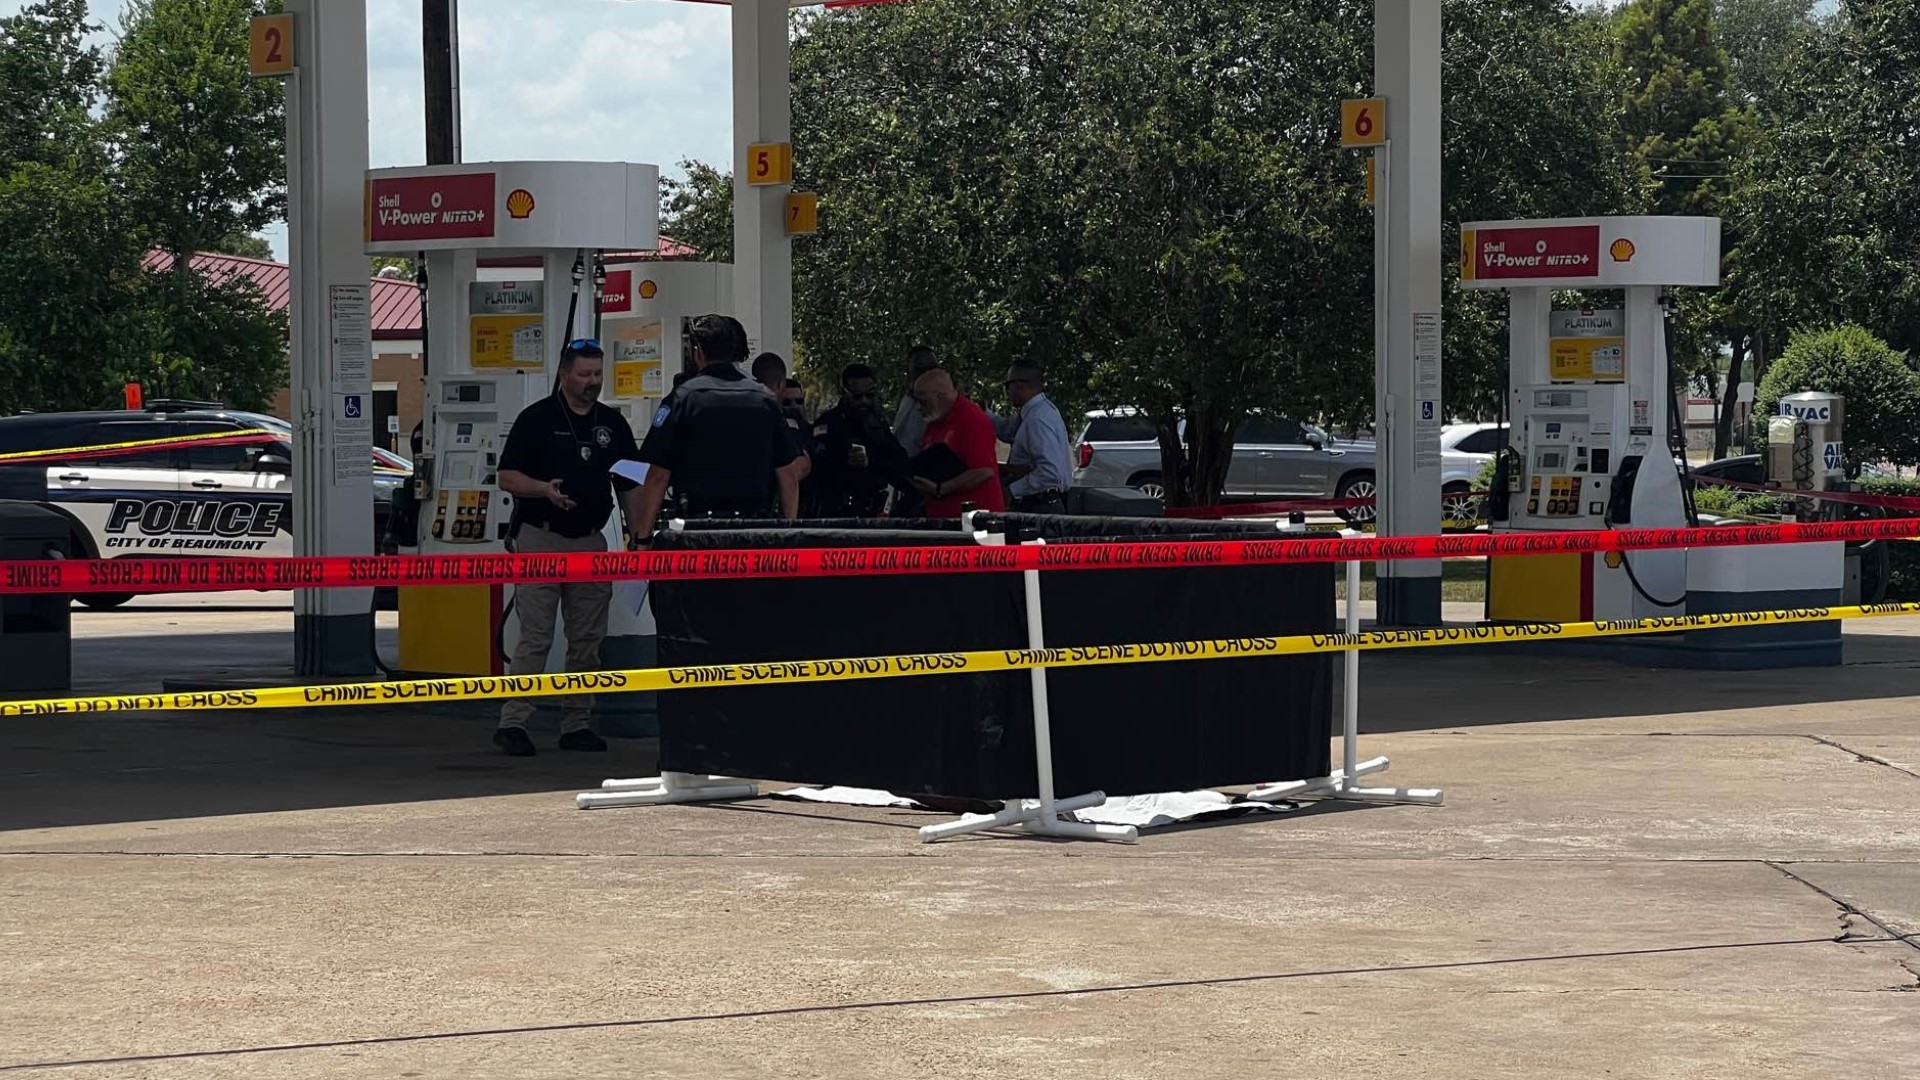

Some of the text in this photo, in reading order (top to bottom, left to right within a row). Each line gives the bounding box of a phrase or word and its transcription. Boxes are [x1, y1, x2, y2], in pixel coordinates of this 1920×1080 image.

[265, 27, 281, 63] 2
[1355, 107, 1373, 136] 6
[757, 151, 769, 177] 5
[378, 193, 400, 208] Shell
[378, 209, 437, 226] V-Power
[792, 206, 799, 221] 7
[1483, 241, 1505, 253] Shell
[1483, 253, 1542, 267] V-Power
[485, 291, 534, 305] PLATINUM
[1564, 317, 1612, 329] PLATINUM
[1794, 407, 1828, 419] VAC
[1825, 443, 1841, 455] AI
[1825, 457, 1841, 469] VA
[104, 498, 285, 538] POLICE
[105, 537, 267, 551] CITY OF BEAUMONT
[350, 556, 568, 581] CRIME SCENE DO NOT CROSS
[592, 553, 799, 576] CRIME SCENE DO NOT CROSS
[820, 549, 1017, 571] CRIME SCENE DO NOT CROSS
[6, 564, 62, 587] CRIME
[89, 561, 324, 586] CRIME SCENE DO NOT CROSS
[1311, 622, 1563, 648] CRIME SCENE DO NOT CROSS
[1005, 637, 1278, 666] CRIME SCENE DO NOT CROSS
[667, 653, 968, 684] CRIME SCENE DO NOT CROSS
[304, 671, 628, 702] CRIME SCENE DO NOT CROSS
[0, 691, 258, 715] CENE DO NOT CROSS
